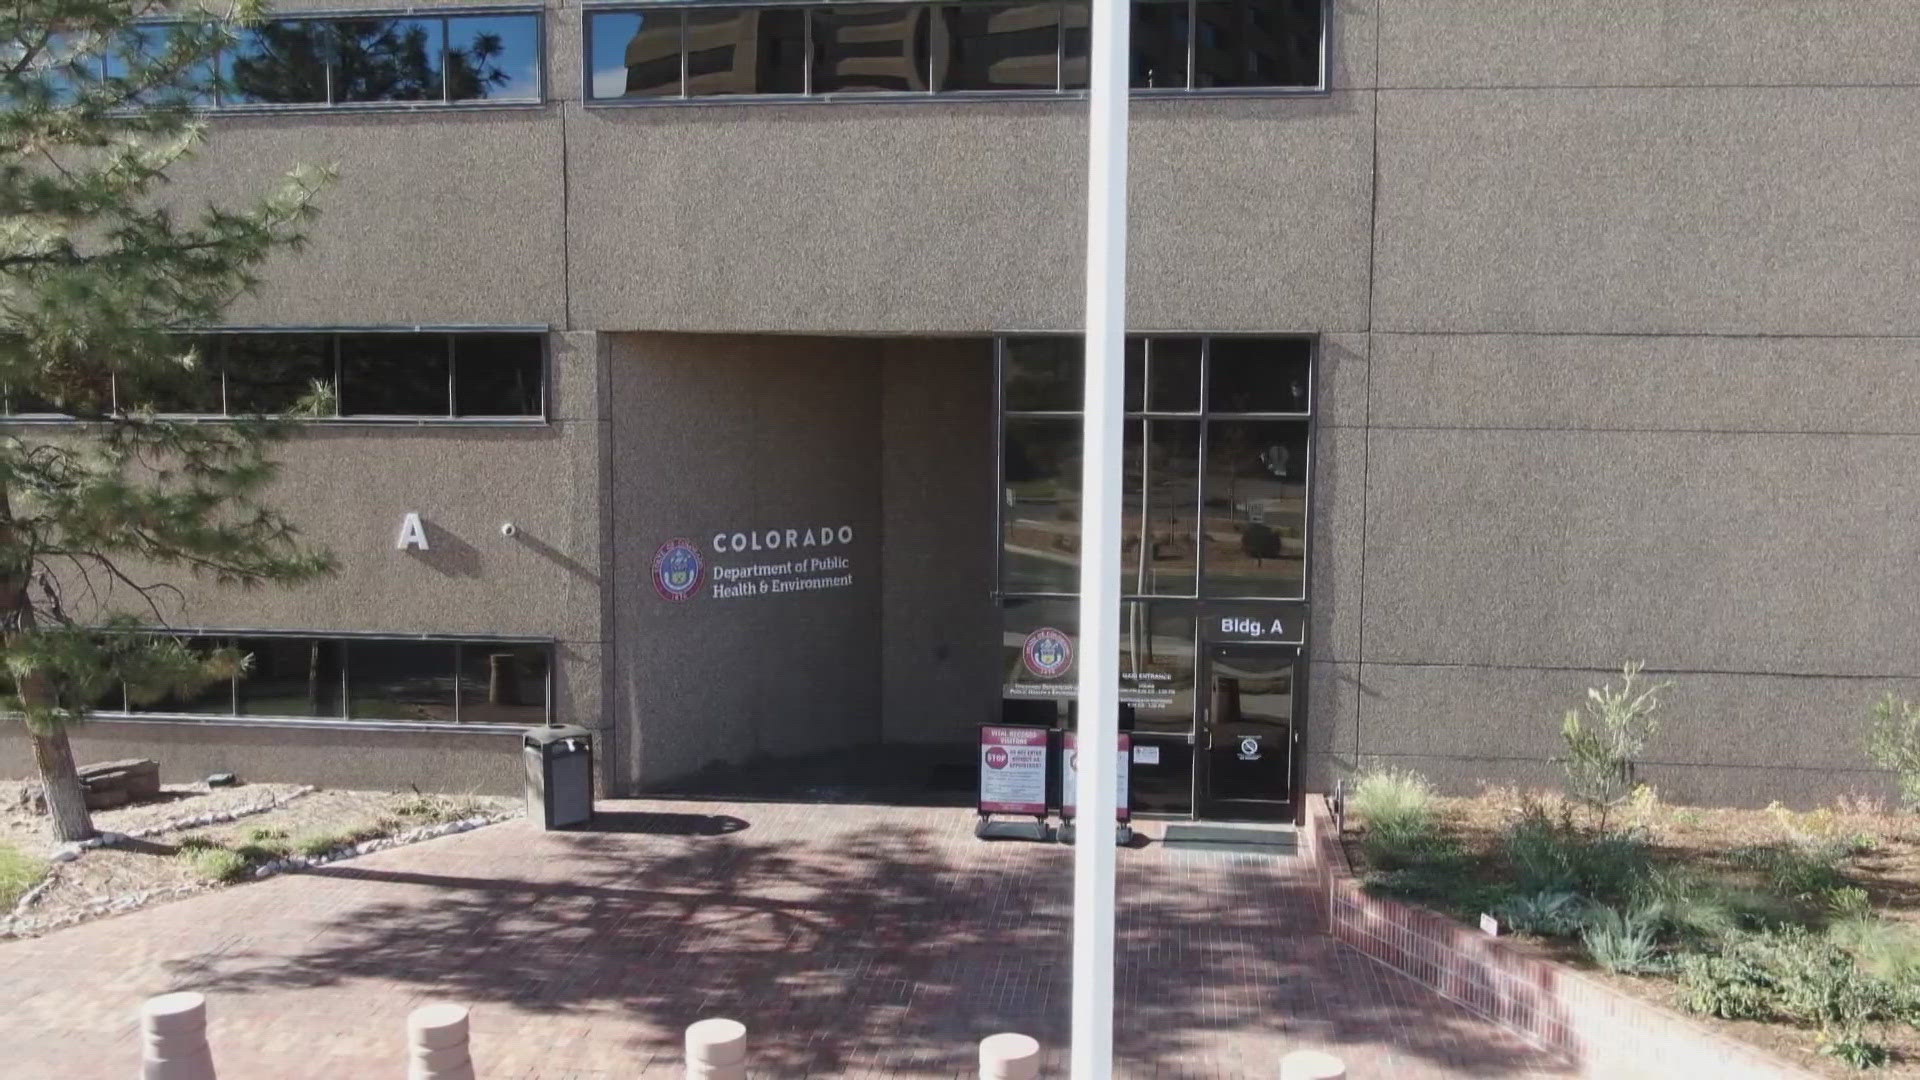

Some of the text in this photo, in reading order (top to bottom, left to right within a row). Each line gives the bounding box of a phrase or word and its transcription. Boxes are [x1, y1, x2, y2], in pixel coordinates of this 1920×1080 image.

[398, 512, 430, 550] A
[713, 526, 853, 553] COLORADO
[713, 556, 849, 581] Department of Public
[712, 573, 853, 599] Health & Environment
[1221, 618, 1283, 636] Bldg. A
[987, 753, 1006, 762] STOP
